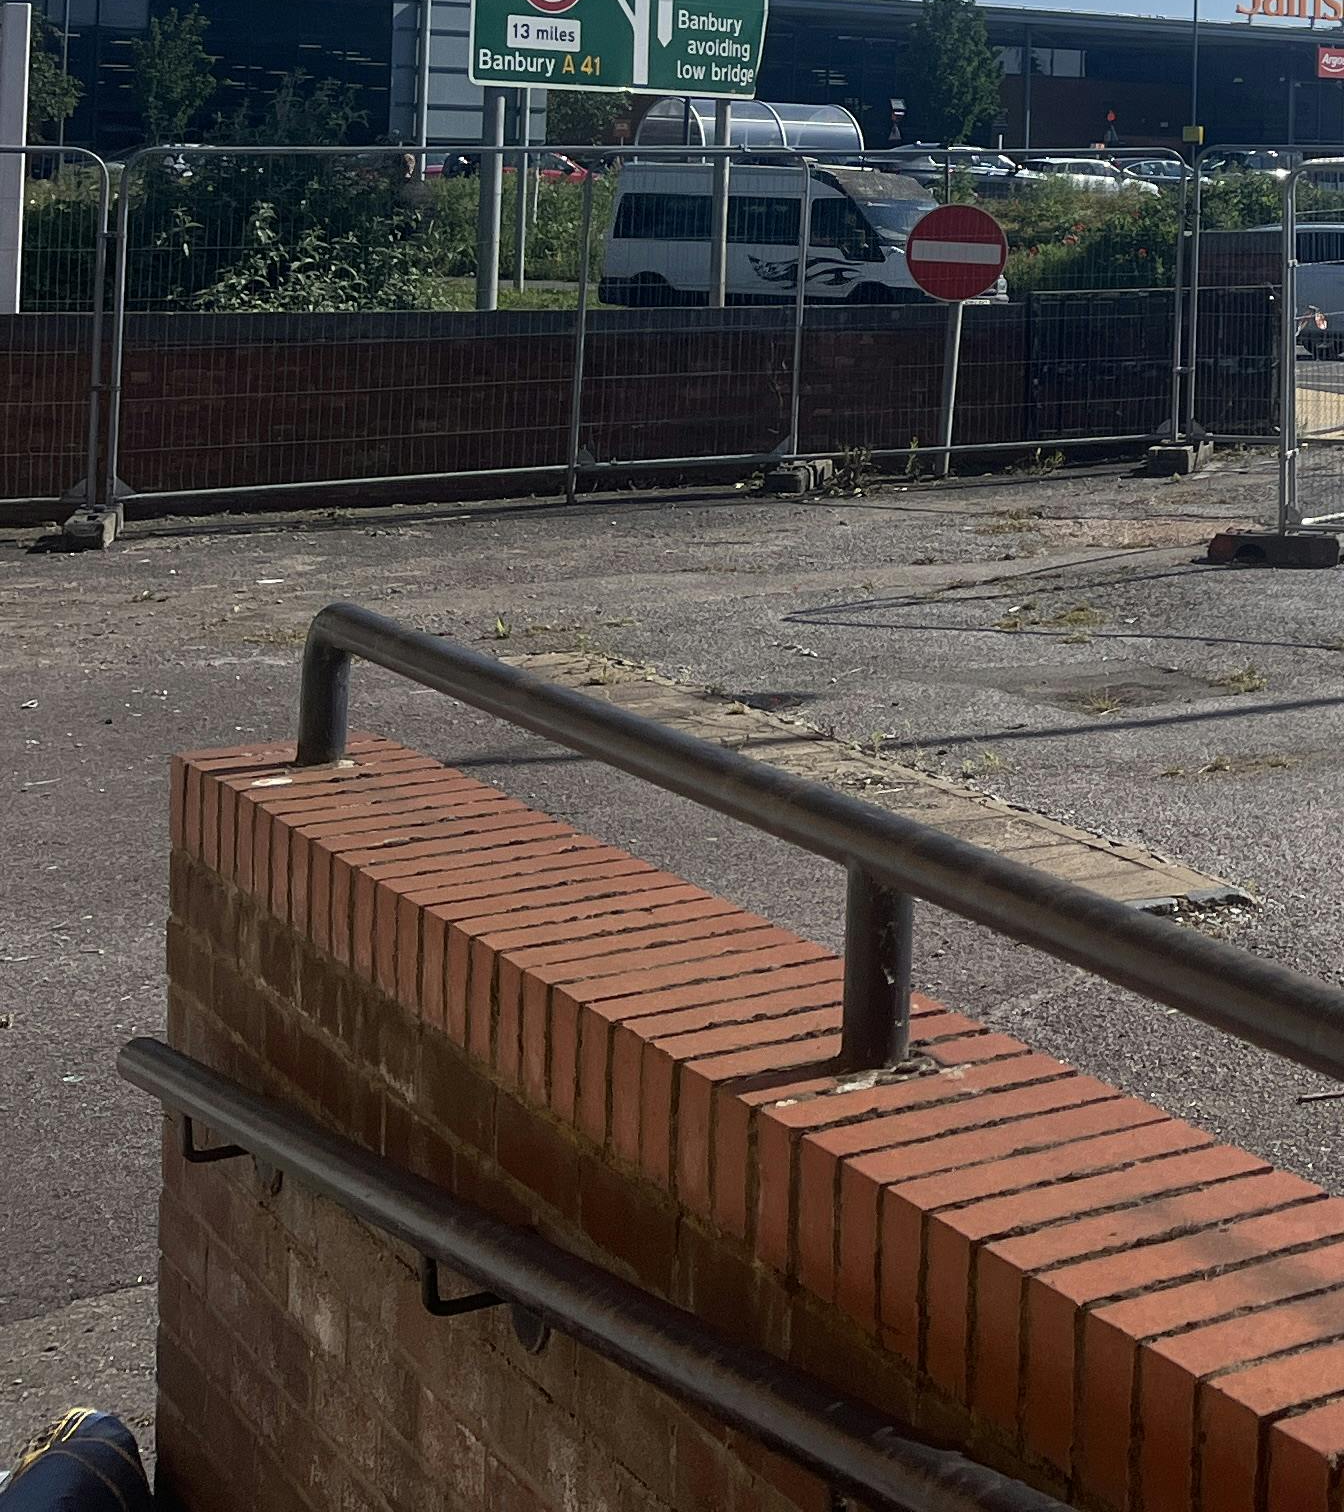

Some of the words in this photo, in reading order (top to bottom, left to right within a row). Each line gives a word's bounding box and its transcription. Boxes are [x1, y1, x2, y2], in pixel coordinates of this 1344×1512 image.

[513, 22, 530, 39] 13
[536, 26, 576, 43] miles
[678, 9, 743, 36] Banbury
[479, 48, 556, 77] Banbury
[562, 54, 575, 75] A
[580, 55, 601, 76] 41
[687, 39, 751, 61] avoiding
[677, 60, 705, 80] low
[711, 61, 754, 86] bridge
